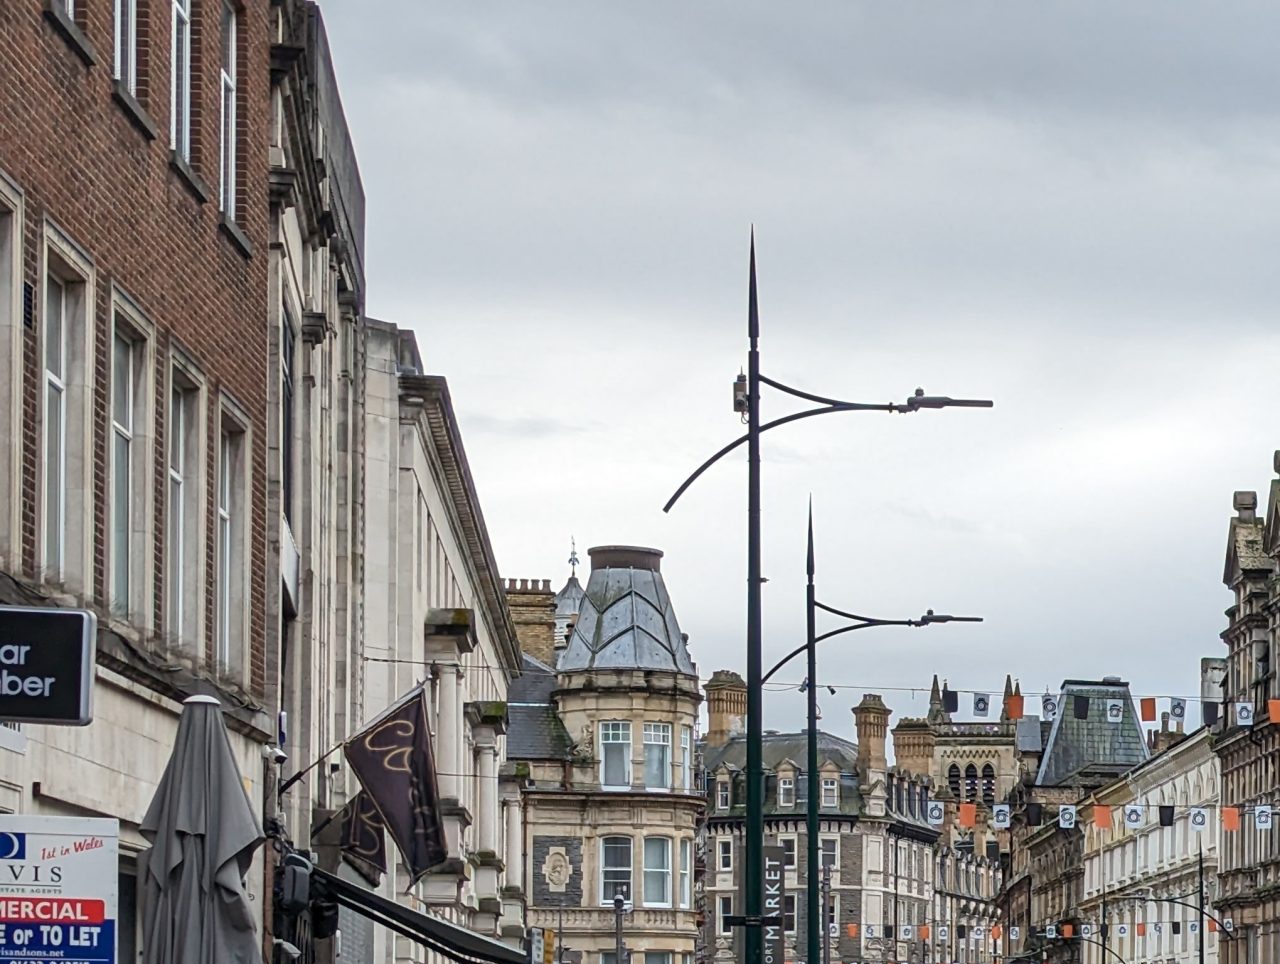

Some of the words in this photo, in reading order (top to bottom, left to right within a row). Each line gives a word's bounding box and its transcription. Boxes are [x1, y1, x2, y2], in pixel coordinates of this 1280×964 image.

[0, 669, 56, 697] ber
[13, 928, 34, 946] or
[40, 925, 63, 946] TO
[69, 926, 102, 947] LET
